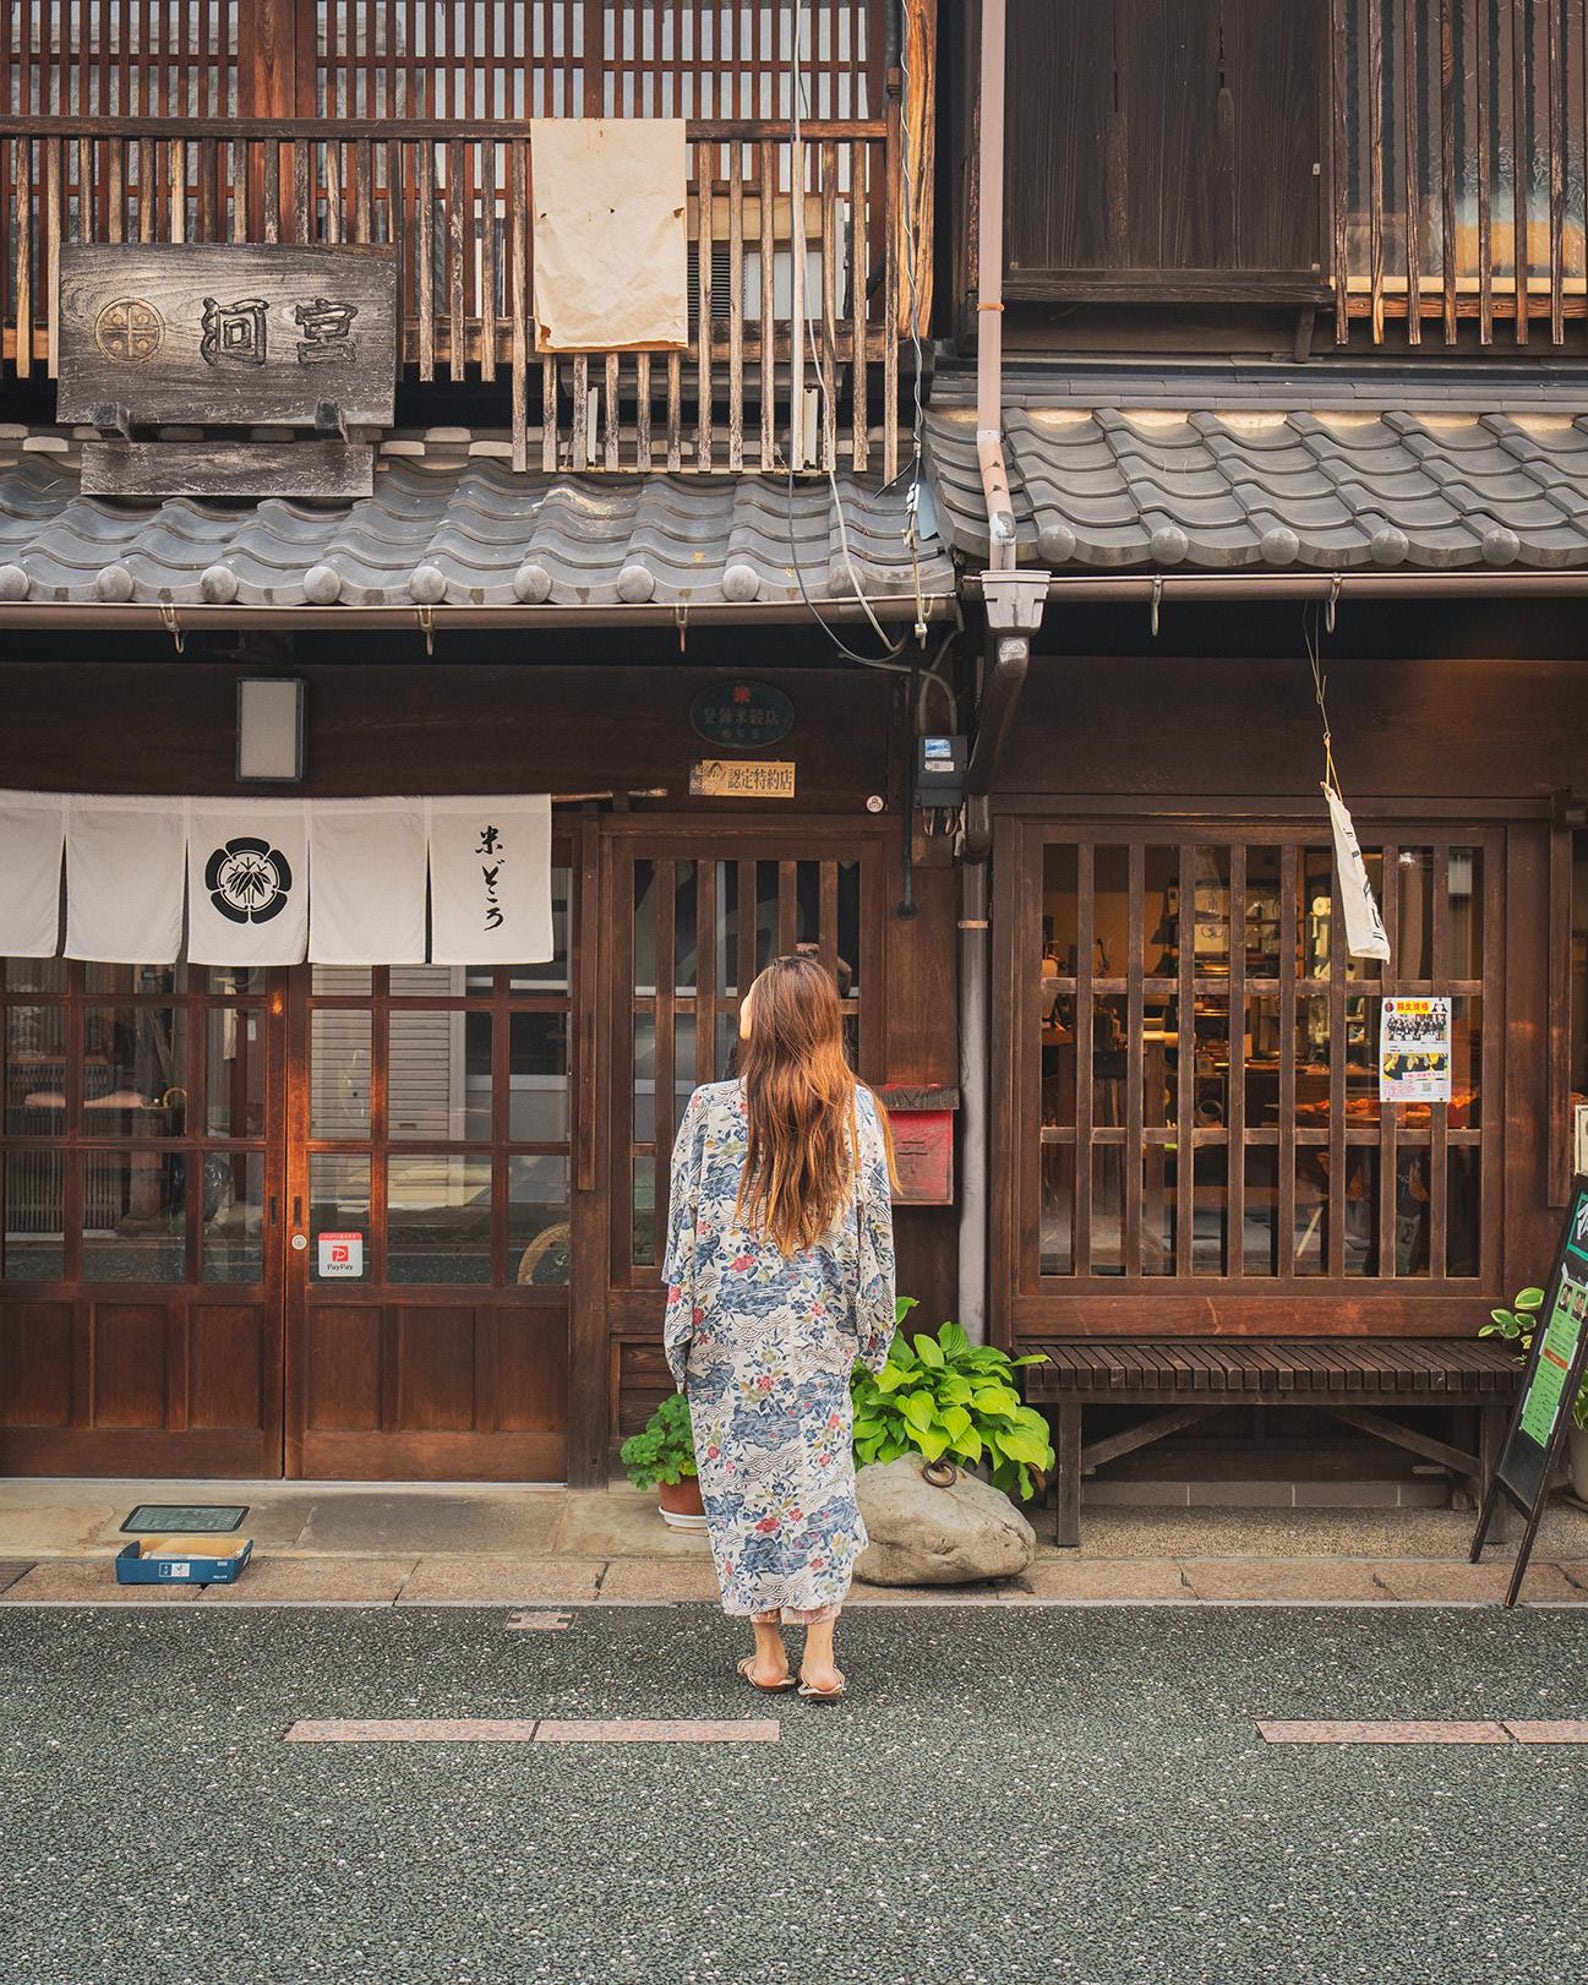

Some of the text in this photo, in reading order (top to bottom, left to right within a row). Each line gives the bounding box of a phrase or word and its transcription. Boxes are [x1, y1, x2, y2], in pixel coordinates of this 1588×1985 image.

[727, 767, 793, 791] 認定特約店
[475, 825, 506, 932] 米どころ
[327, 1263, 353, 1271] PayPay
